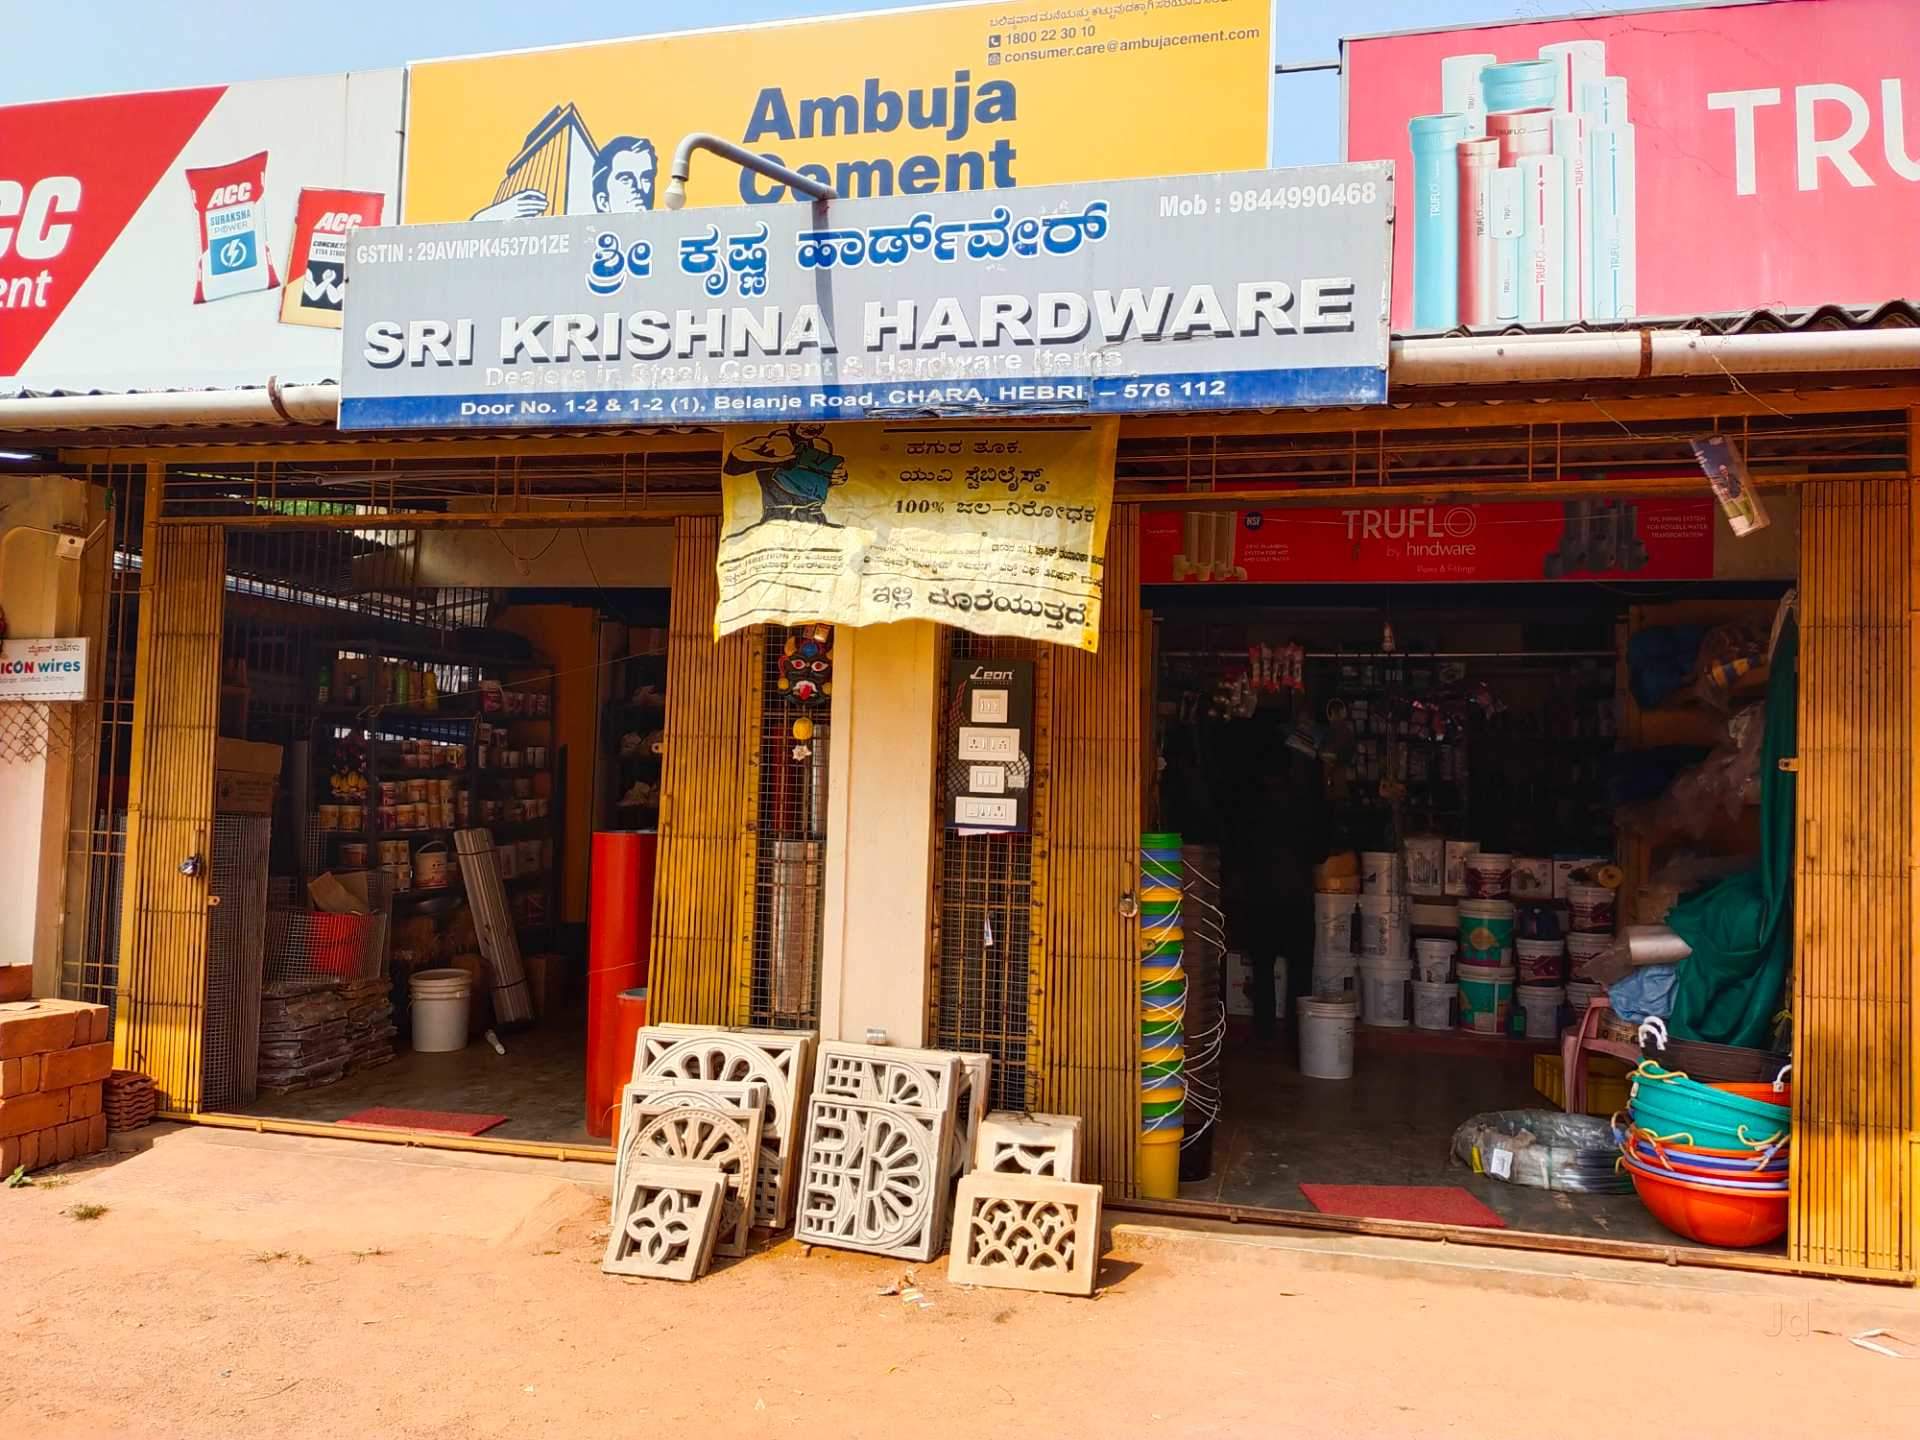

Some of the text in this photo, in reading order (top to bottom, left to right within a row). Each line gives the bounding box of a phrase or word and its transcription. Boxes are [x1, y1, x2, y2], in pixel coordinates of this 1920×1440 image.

[1004, 28, 1260, 63] consumer.care@ambujacement.com
[1005, 25, 1095, 45] 1800 22 30 10
[742, 70, 1017, 143] Ambuja
[207, 182, 252, 208] ACC
[1160, 194, 1207, 217] Mob
[1229, 182, 1376, 213] 9844990468
[210, 208, 251, 226] SURAKSHA
[357, 244, 403, 264] GSTIN
[417, 234, 569, 260] 29AVMPK4537D1ZE
[586, 232, 652, 294] ಶ್ರೀ
[679, 222, 768, 296] ಕೃಷ್ಣ
[363, 277, 1355, 368] SRI KRISHNA HARDWARE
[486, 367, 585, 387] Dealers
[876, 352, 1022, 376] Hardware
[461, 401, 514, 415] Door
[521, 400, 556, 413] No.
[565, 399, 597, 412] 1-2
[605, 398, 621, 411] &
[630, 397, 663, 411] 1-2
[671, 396, 705, 413] (1),
[714, 394, 801, 411] Belanje
[810, 392, 879, 409] Road,
[889, 387, 990, 405] CHARA,
[999, 385, 1083, 400] HEBRI
[1124, 382, 1170, 398] 576
[1180, 380, 1226, 396] 112
[906, 440, 962, 455] ಹಗುರ
[895, 500, 944, 513] 100%
[1342, 507, 1476, 539] TRUFLO
[1406, 541, 1476, 557] hindware
[872, 585, 913, 610] ಇಲ್ಲಿ
[38, 658, 81, 672] wires
[970, 666, 1013, 681] Leon
